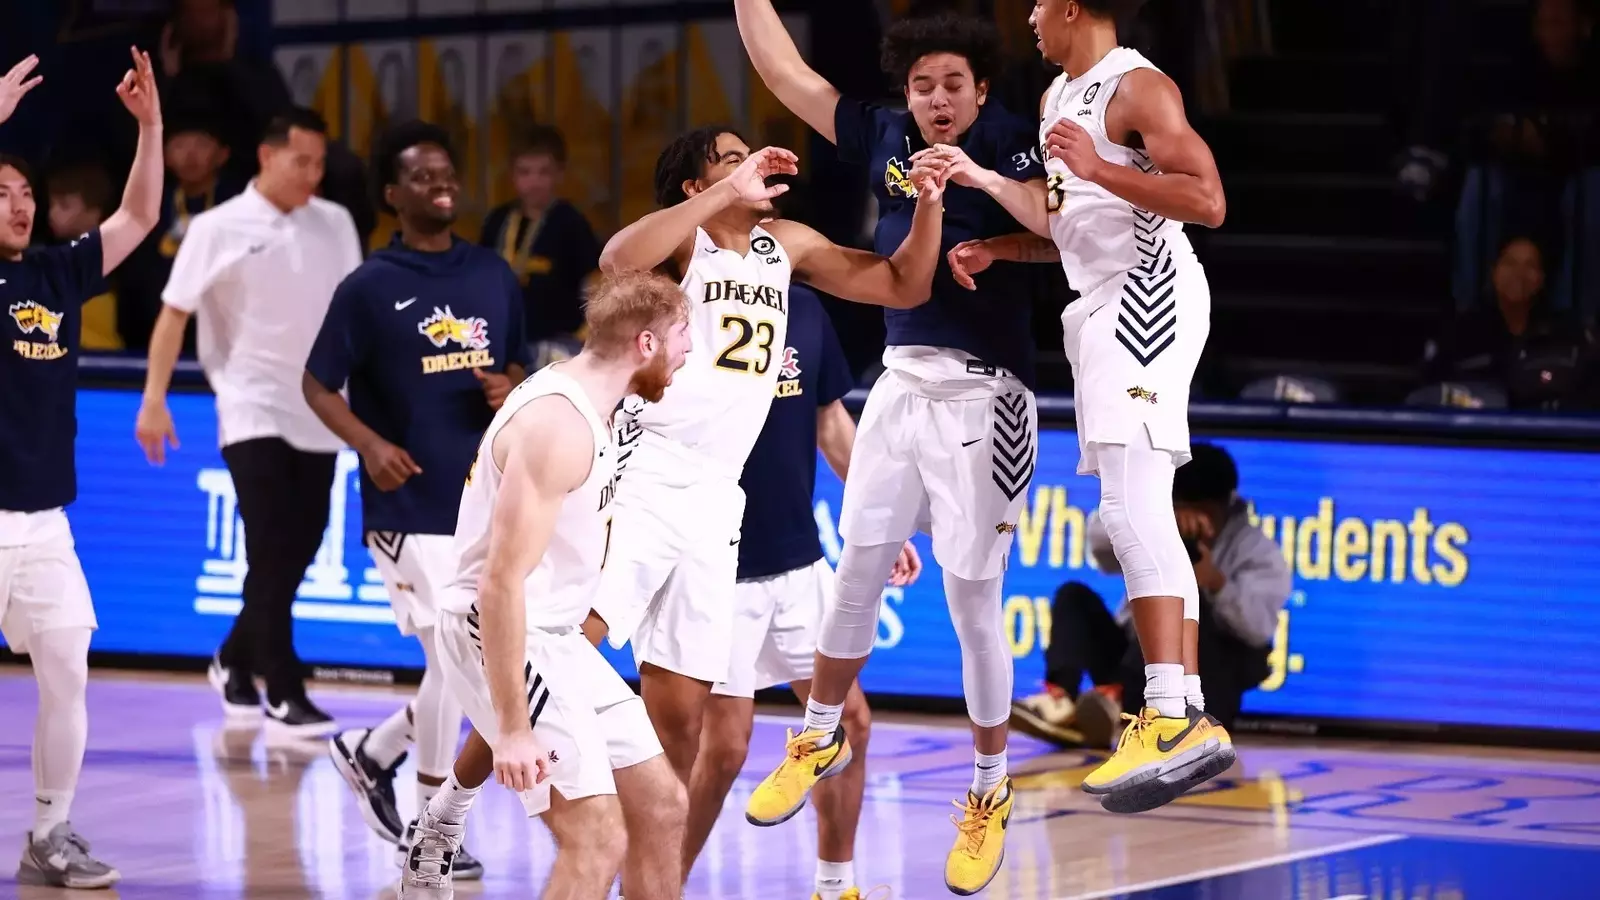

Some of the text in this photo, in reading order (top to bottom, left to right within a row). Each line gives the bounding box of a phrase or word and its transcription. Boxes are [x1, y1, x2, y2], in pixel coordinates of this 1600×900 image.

[765, 255, 782, 265] CAA
[702, 279, 786, 316] DREXEL
[713, 314, 776, 376] 23
[421, 349, 495, 374] DREXEL
